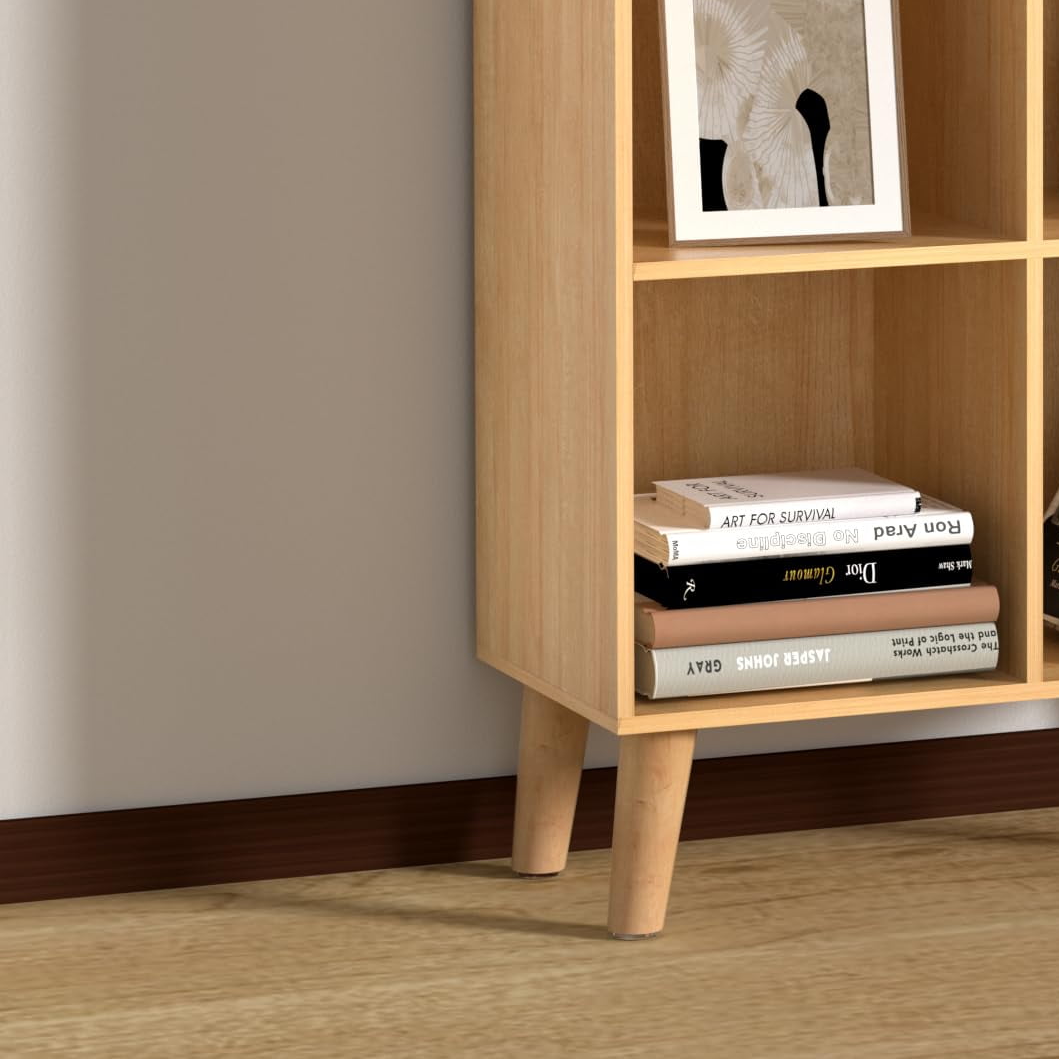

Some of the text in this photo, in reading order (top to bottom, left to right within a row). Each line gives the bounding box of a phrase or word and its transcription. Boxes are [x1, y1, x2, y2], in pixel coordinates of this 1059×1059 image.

[720, 507, 836, 529] ART FOR SURVIVAL
[736, 519, 961, 551] Ron Arad No Discipline
[672, 540, 680, 560] MoMA
[938, 559, 973, 571] Mark Shaw
[782, 562, 877, 585] Dior Glamour
[930, 632, 955, 644] Logic
[959, 631, 974, 640] the
[978, 630, 997, 638] and
[892, 638, 914, 647] Print
[893, 642, 1000, 658] The Crosshatch Works
[687, 648, 831, 675] JASPER JOHNS GRAY
